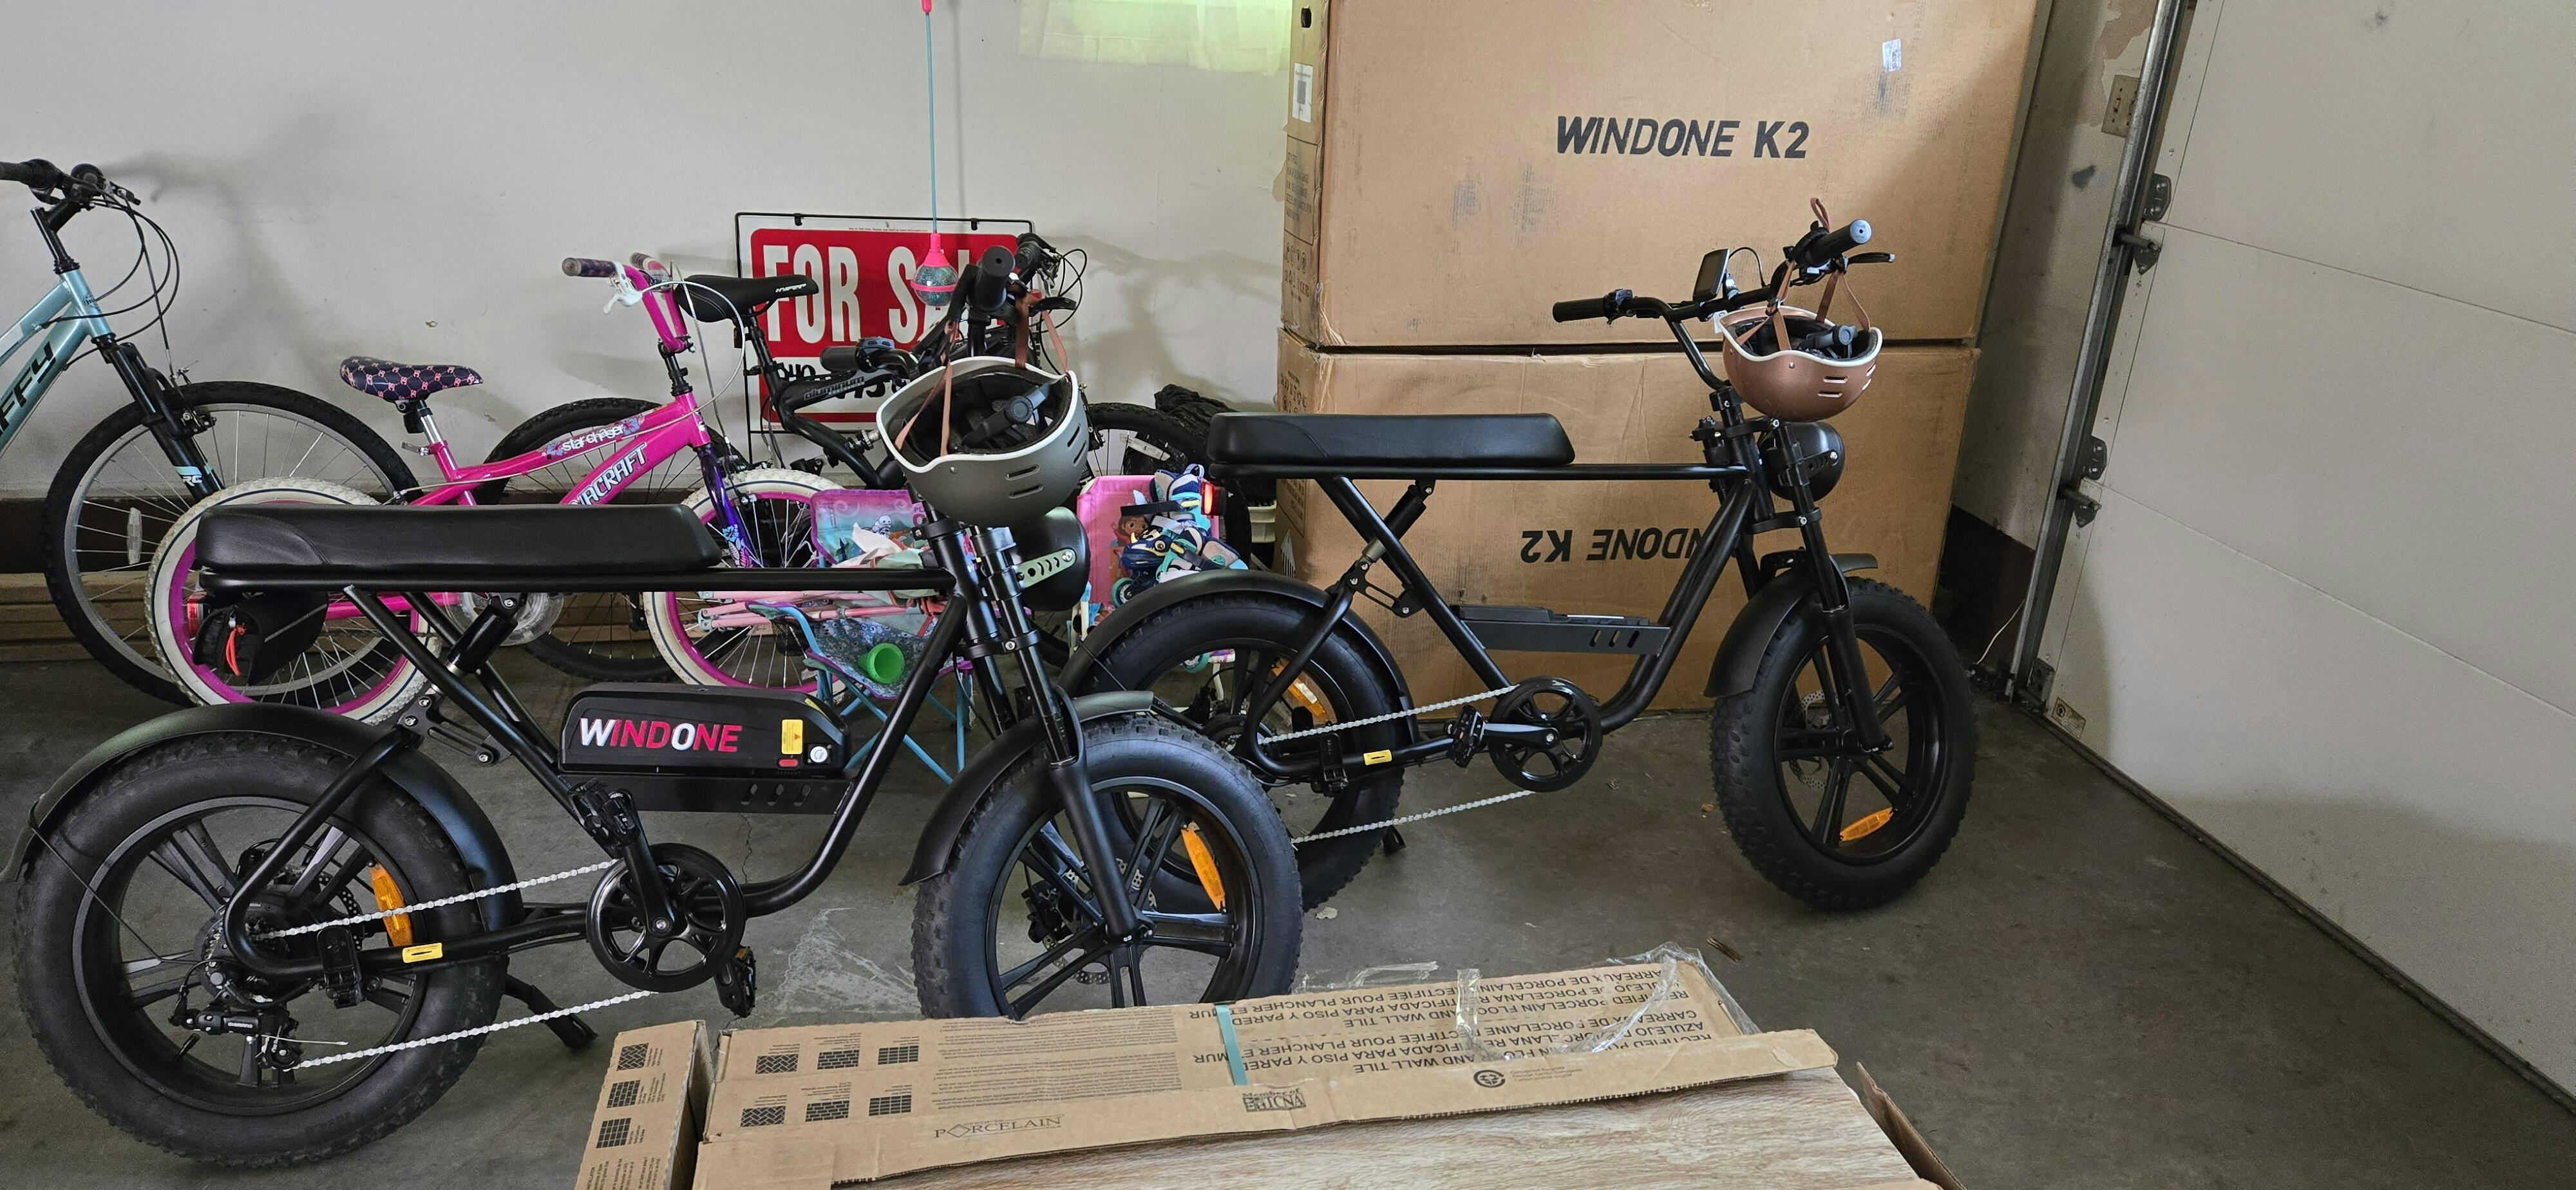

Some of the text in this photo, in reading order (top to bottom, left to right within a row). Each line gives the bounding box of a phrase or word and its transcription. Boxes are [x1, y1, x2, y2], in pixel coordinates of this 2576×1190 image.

[1557, 115, 1810, 159] WINDONE K2
[763, 243, 861, 344] FOR
[0, 341, 56, 437] FFY
[1520, 527, 1707, 563] NDONE K2
[580, 717, 743, 753] WINDONE
[1570, 976, 1591, 985] DE
[1593, 969, 1665, 982] ARREAUX
[1477, 978, 1567, 993] PORCELAIN
[1340, 994, 1384, 1005] POUR
[1492, 988, 1586, 1003] PORCELANA
[1252, 999, 1337, 1012] PLANCHER
[1343, 1005, 1384, 1015] PARA
[1473, 1005, 1519, 1015] FLOO
[1233, 1013, 1283, 1026] PARED
[1289, 1012, 1299, 1020] Y
[1303, 1008, 1339, 1019] PISO
[1381, 1013, 1426, 1024] WALL
[1343, 1017, 1378, 1028] TILE
[1589, 1017, 1610, 1028] DE
[1636, 1021, 1703, 1036] AZULEJO
[1350, 1035, 1396, 1047] POUR
[1260, 1041, 1345, 1056] PLANCHER
[1352, 1048, 1396, 1060] PARA
[1298, 1055, 1307, 1064] Y
[1311, 1052, 1349, 1064] PISO
[1392, 1057, 1439, 1069] WALL
[1443, 1053, 1475, 1065] AND
[1354, 1062, 1390, 1073] TILE
